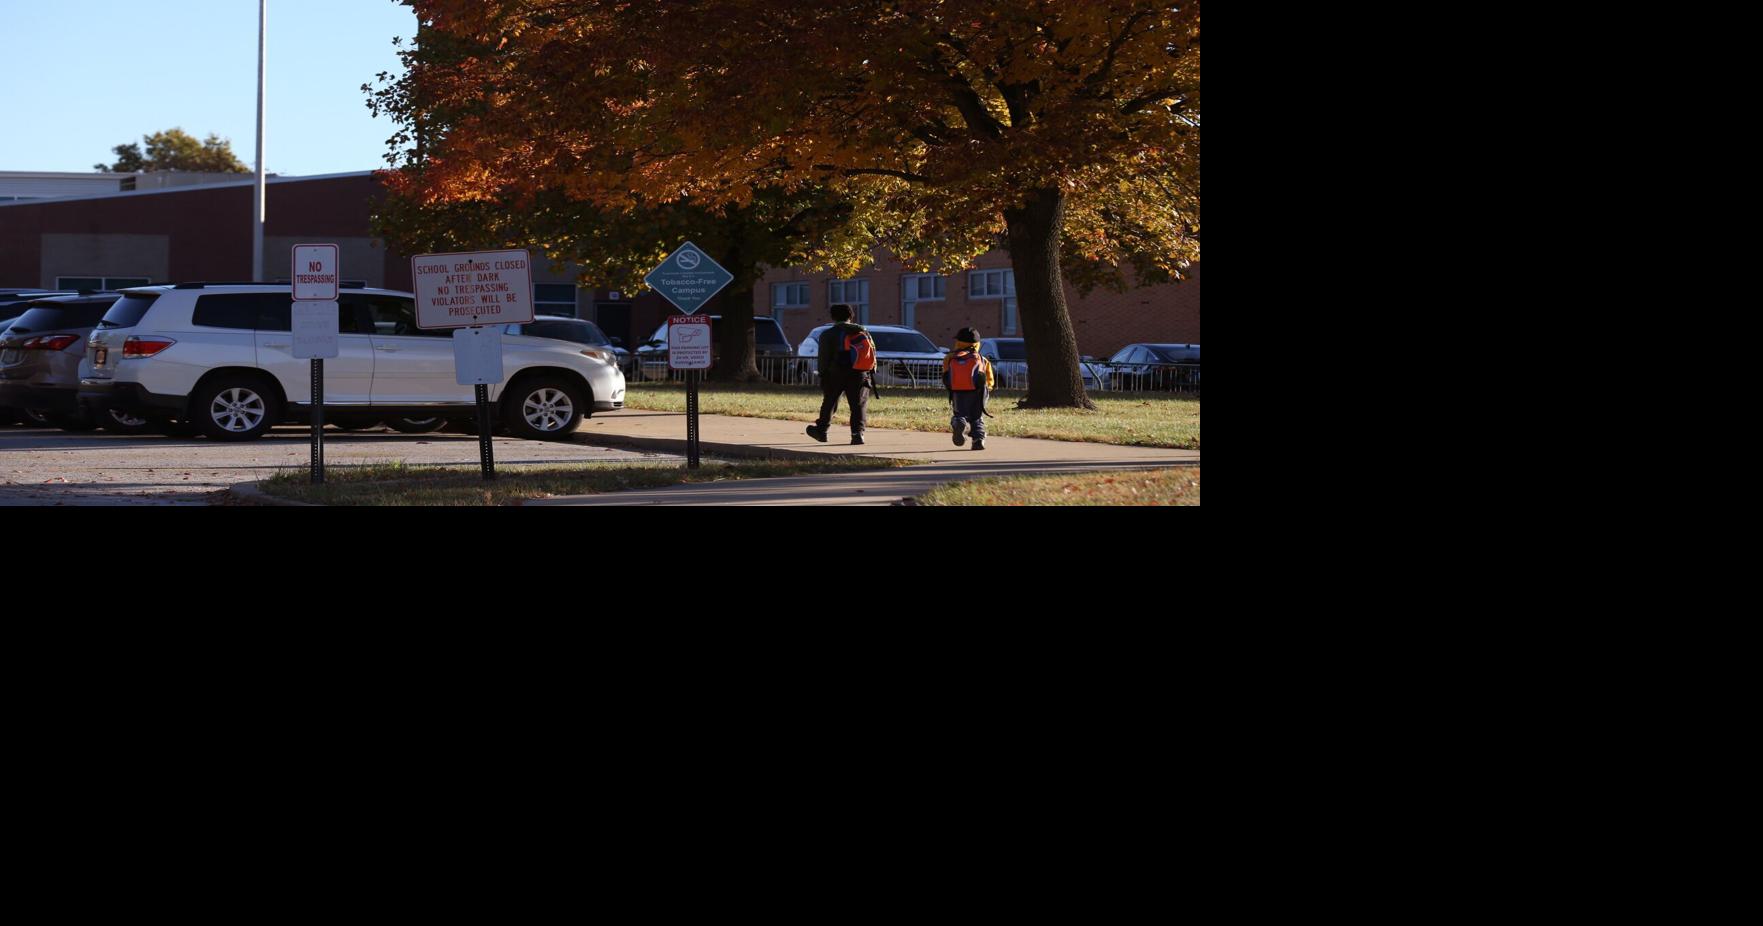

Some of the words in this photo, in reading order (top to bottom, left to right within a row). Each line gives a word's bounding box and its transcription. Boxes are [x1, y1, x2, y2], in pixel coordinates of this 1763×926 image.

[309, 262, 322, 272] NO
[417, 265, 449, 275] SCHOOL
[455, 262, 491, 272] GROUNDS
[494, 260, 526, 270] CLOSED
[297, 274, 335, 284] TRESPASSING
[477, 272, 500, 282] DARK
[661, 278, 716, 286] Tobacco-Free
[437, 286, 449, 295] NO
[455, 283, 509, 294] TRESPASSING
[671, 287, 706, 295] Campus
[431, 295, 476, 306] VIOLATORS
[481, 294, 500, 303] WILL
[506, 293, 517, 302] BE
[448, 305, 501, 316] PROSECUTED
